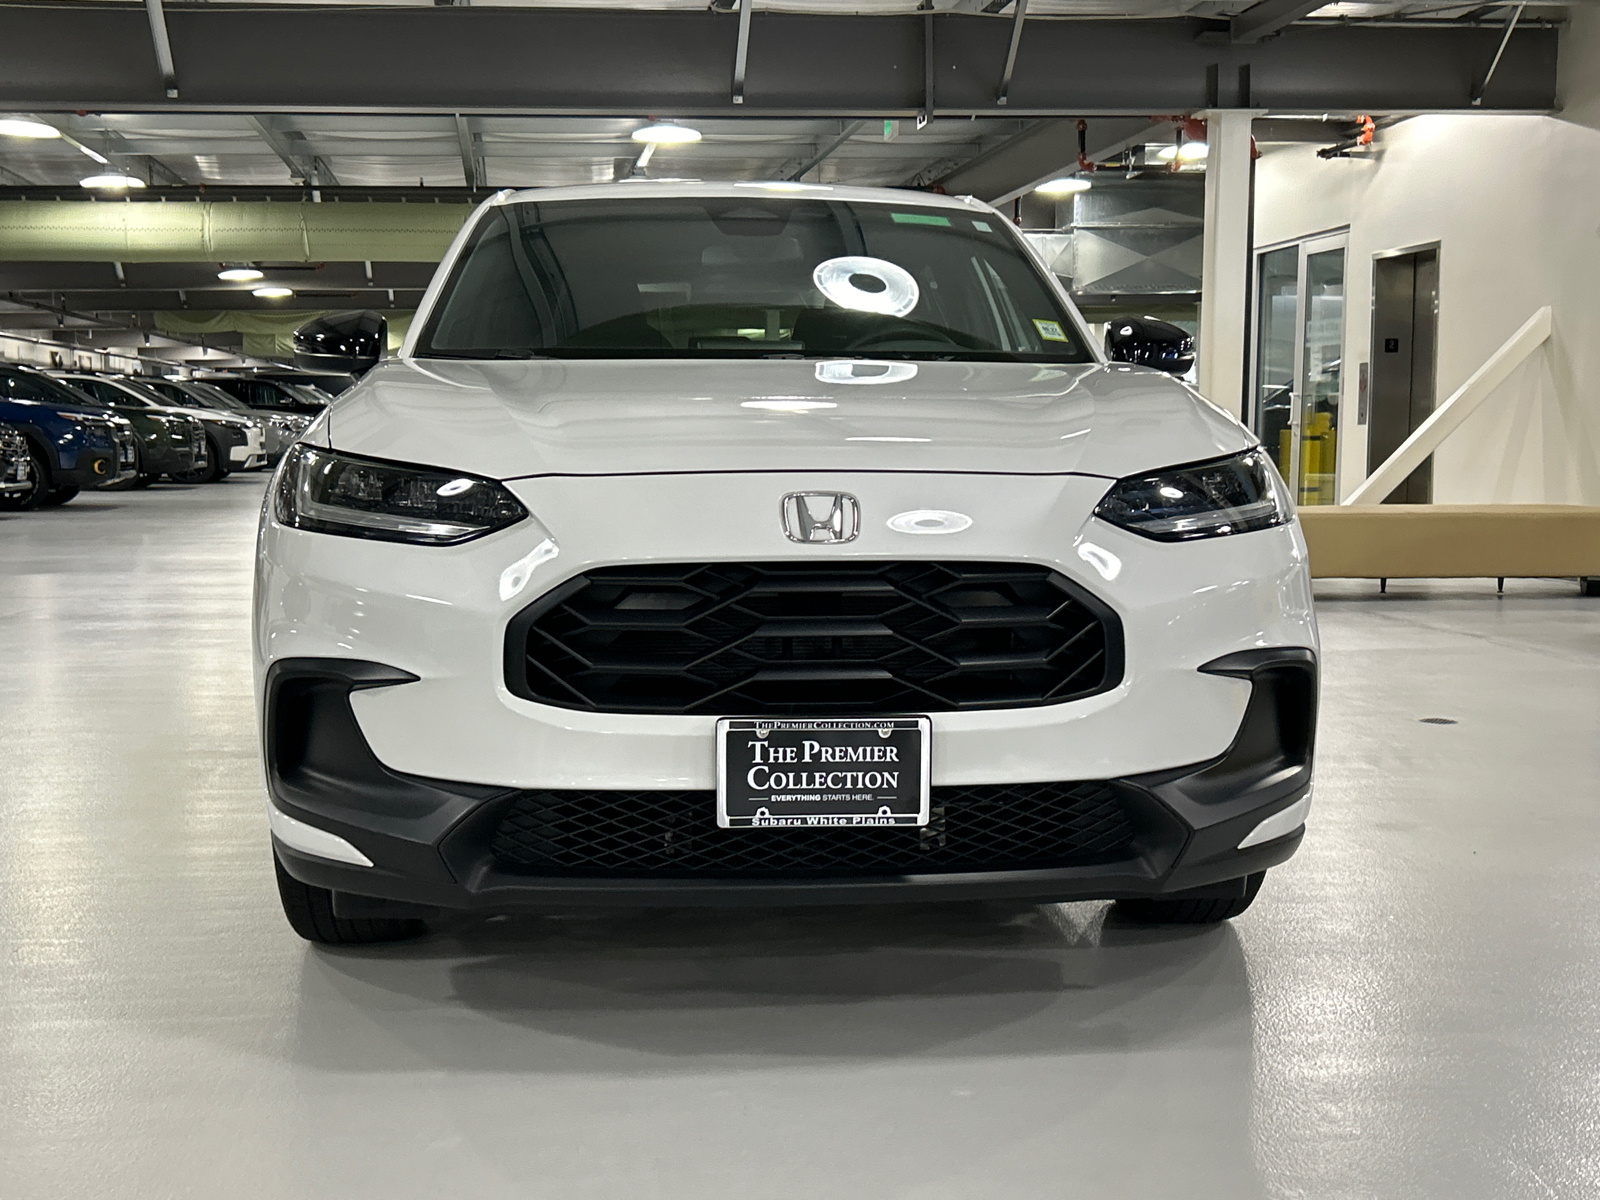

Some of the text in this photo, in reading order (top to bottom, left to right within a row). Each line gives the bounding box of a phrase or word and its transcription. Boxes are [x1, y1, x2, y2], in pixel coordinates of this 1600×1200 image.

[748, 741, 899, 763] THE PREMIER
[747, 765, 899, 790] COLLECTION
[771, 794, 821, 802] EVERYTHING
[752, 816, 895, 826] Subaru White Plains
